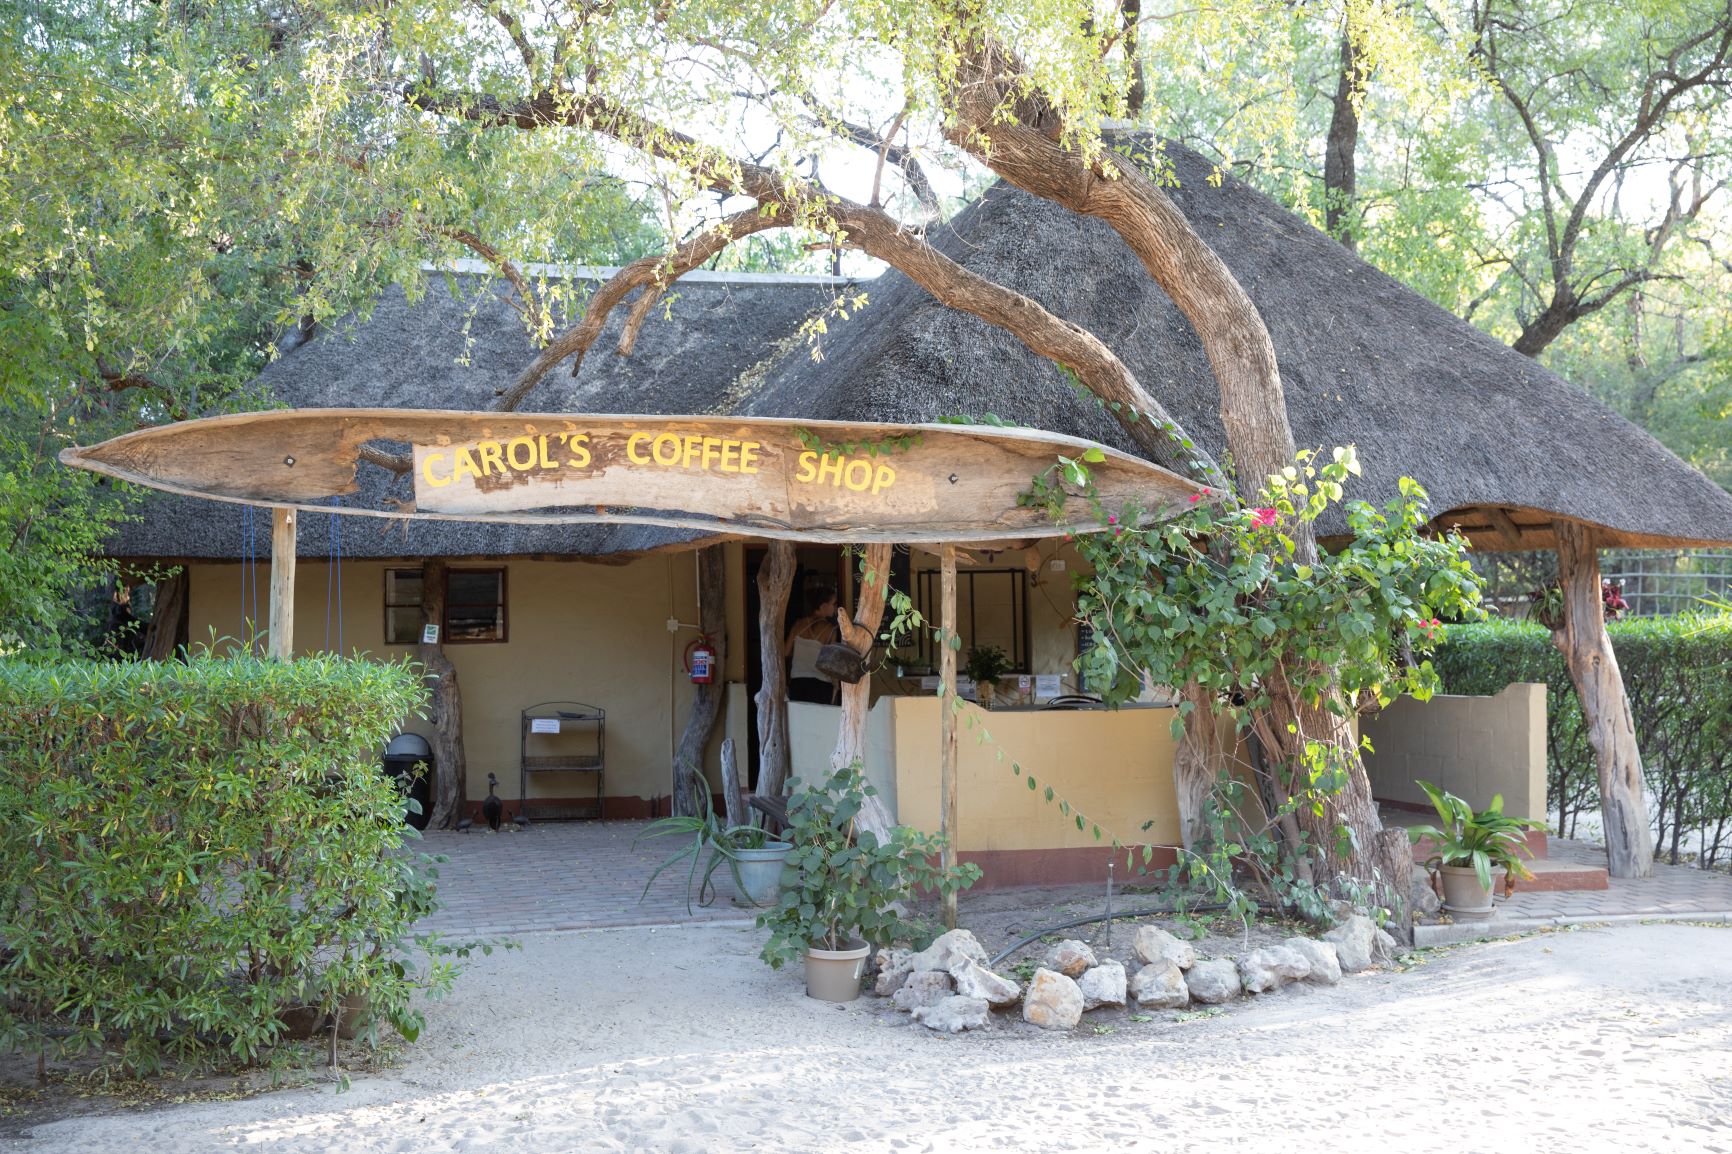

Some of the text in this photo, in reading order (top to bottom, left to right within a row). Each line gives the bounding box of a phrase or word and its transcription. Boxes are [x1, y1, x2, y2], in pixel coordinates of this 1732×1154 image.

[422, 431, 897, 495] CAROL'S COFFEE SHOP
